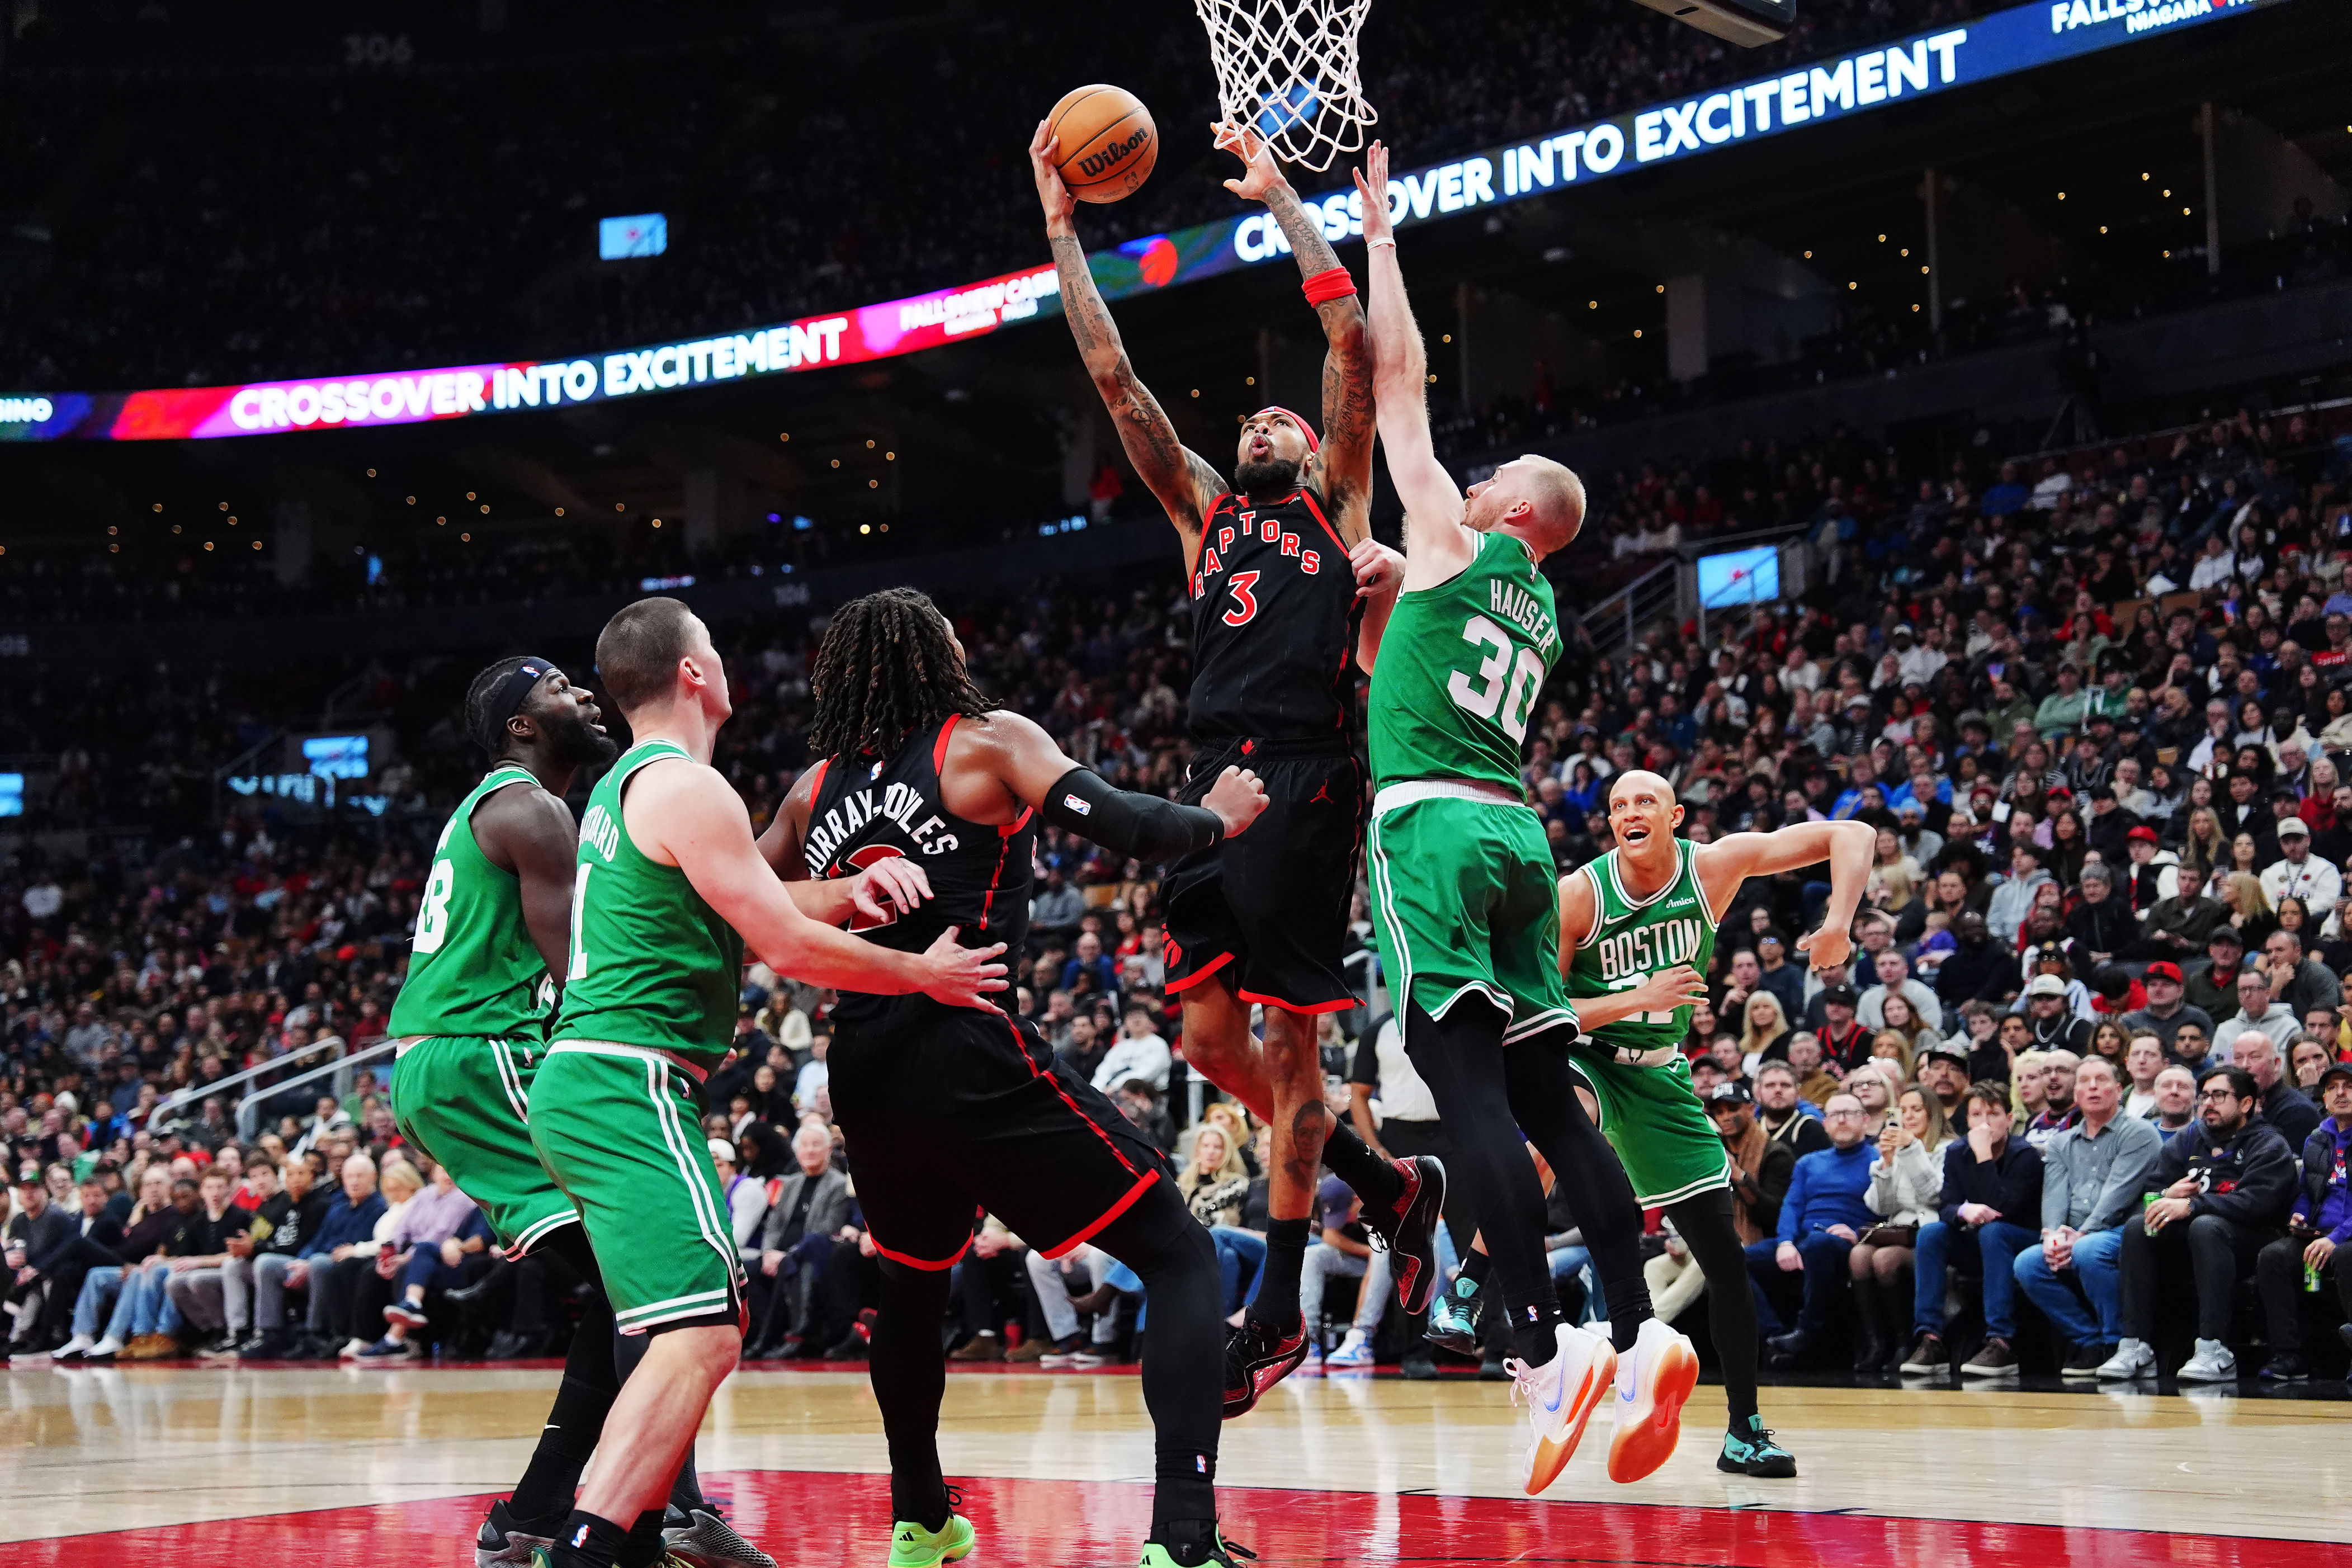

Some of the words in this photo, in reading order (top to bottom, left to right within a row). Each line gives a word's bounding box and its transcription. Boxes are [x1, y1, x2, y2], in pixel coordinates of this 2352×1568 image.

[2126, 0, 2213, 34] NIAGARA
[1503, 123, 1624, 197] INTO
[1634, 29, 1967, 163] EXCITEMENT
[1078, 126, 1148, 177] Wilson
[230, 371, 487, 429] CROSSOVER
[493, 360, 598, 409] INTO
[603, 317, 848, 396] EXCITEMENT
[1195, 510, 1320, 601] RAPTORS
[1222, 570, 1260, 627] 3
[1490, 578, 1556, 655] HAUSER
[1447, 615, 1545, 747] 30
[1665, 896, 1695, 909] Amica
[1599, 918, 1701, 980] BOSTON
